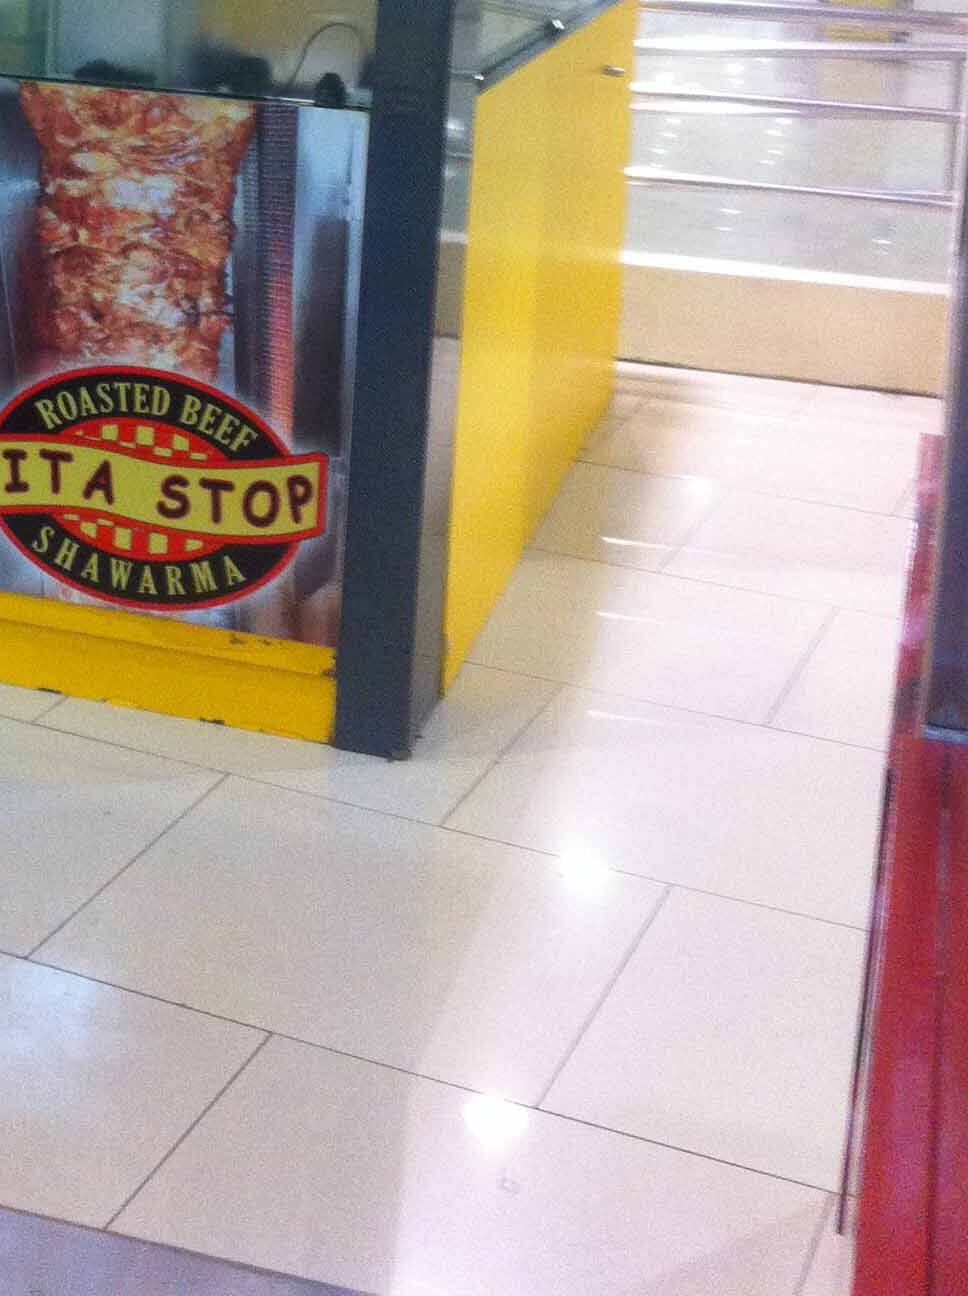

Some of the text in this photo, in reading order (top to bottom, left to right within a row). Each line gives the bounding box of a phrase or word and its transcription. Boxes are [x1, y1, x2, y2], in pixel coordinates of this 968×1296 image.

[35, 382, 258, 452] ROASTED BEEF
[157, 474, 313, 528] STOP
[31, 526, 246, 597] SHAWARMA
